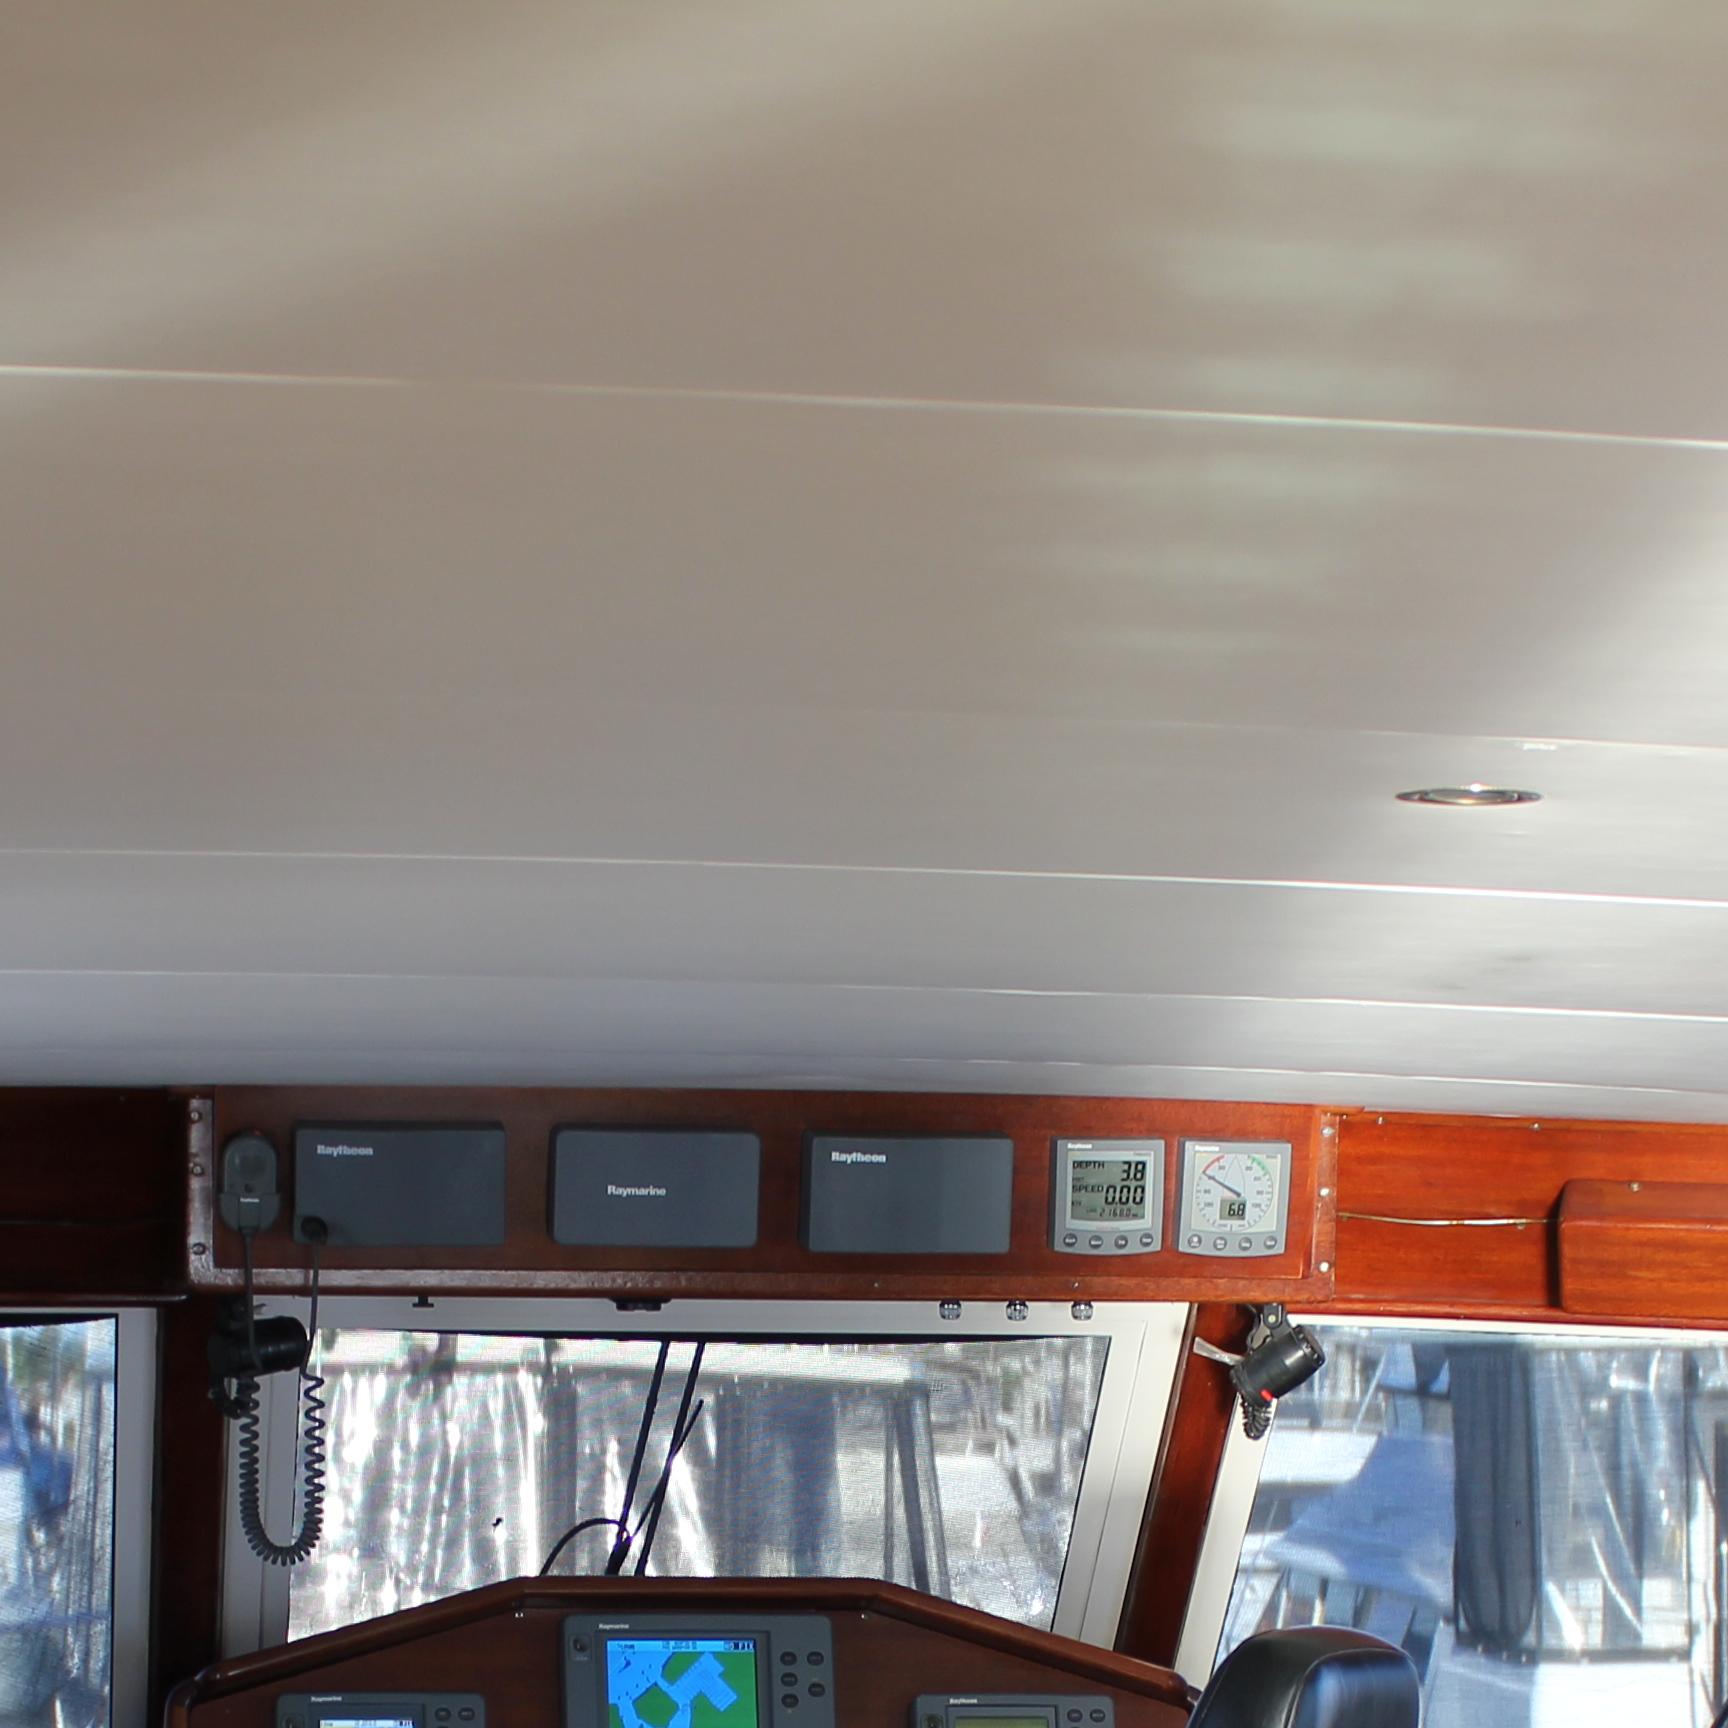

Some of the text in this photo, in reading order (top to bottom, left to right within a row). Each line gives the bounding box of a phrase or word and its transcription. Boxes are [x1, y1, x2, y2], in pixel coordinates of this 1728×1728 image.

[317, 1144, 373, 1157] Raytheon
[831, 1151, 886, 1164] Raytheon
[1072, 1161, 1105, 1169] DEPTH
[607, 1185, 666, 1197] Raymarine
[1072, 1185, 1104, 1193] SPEED
